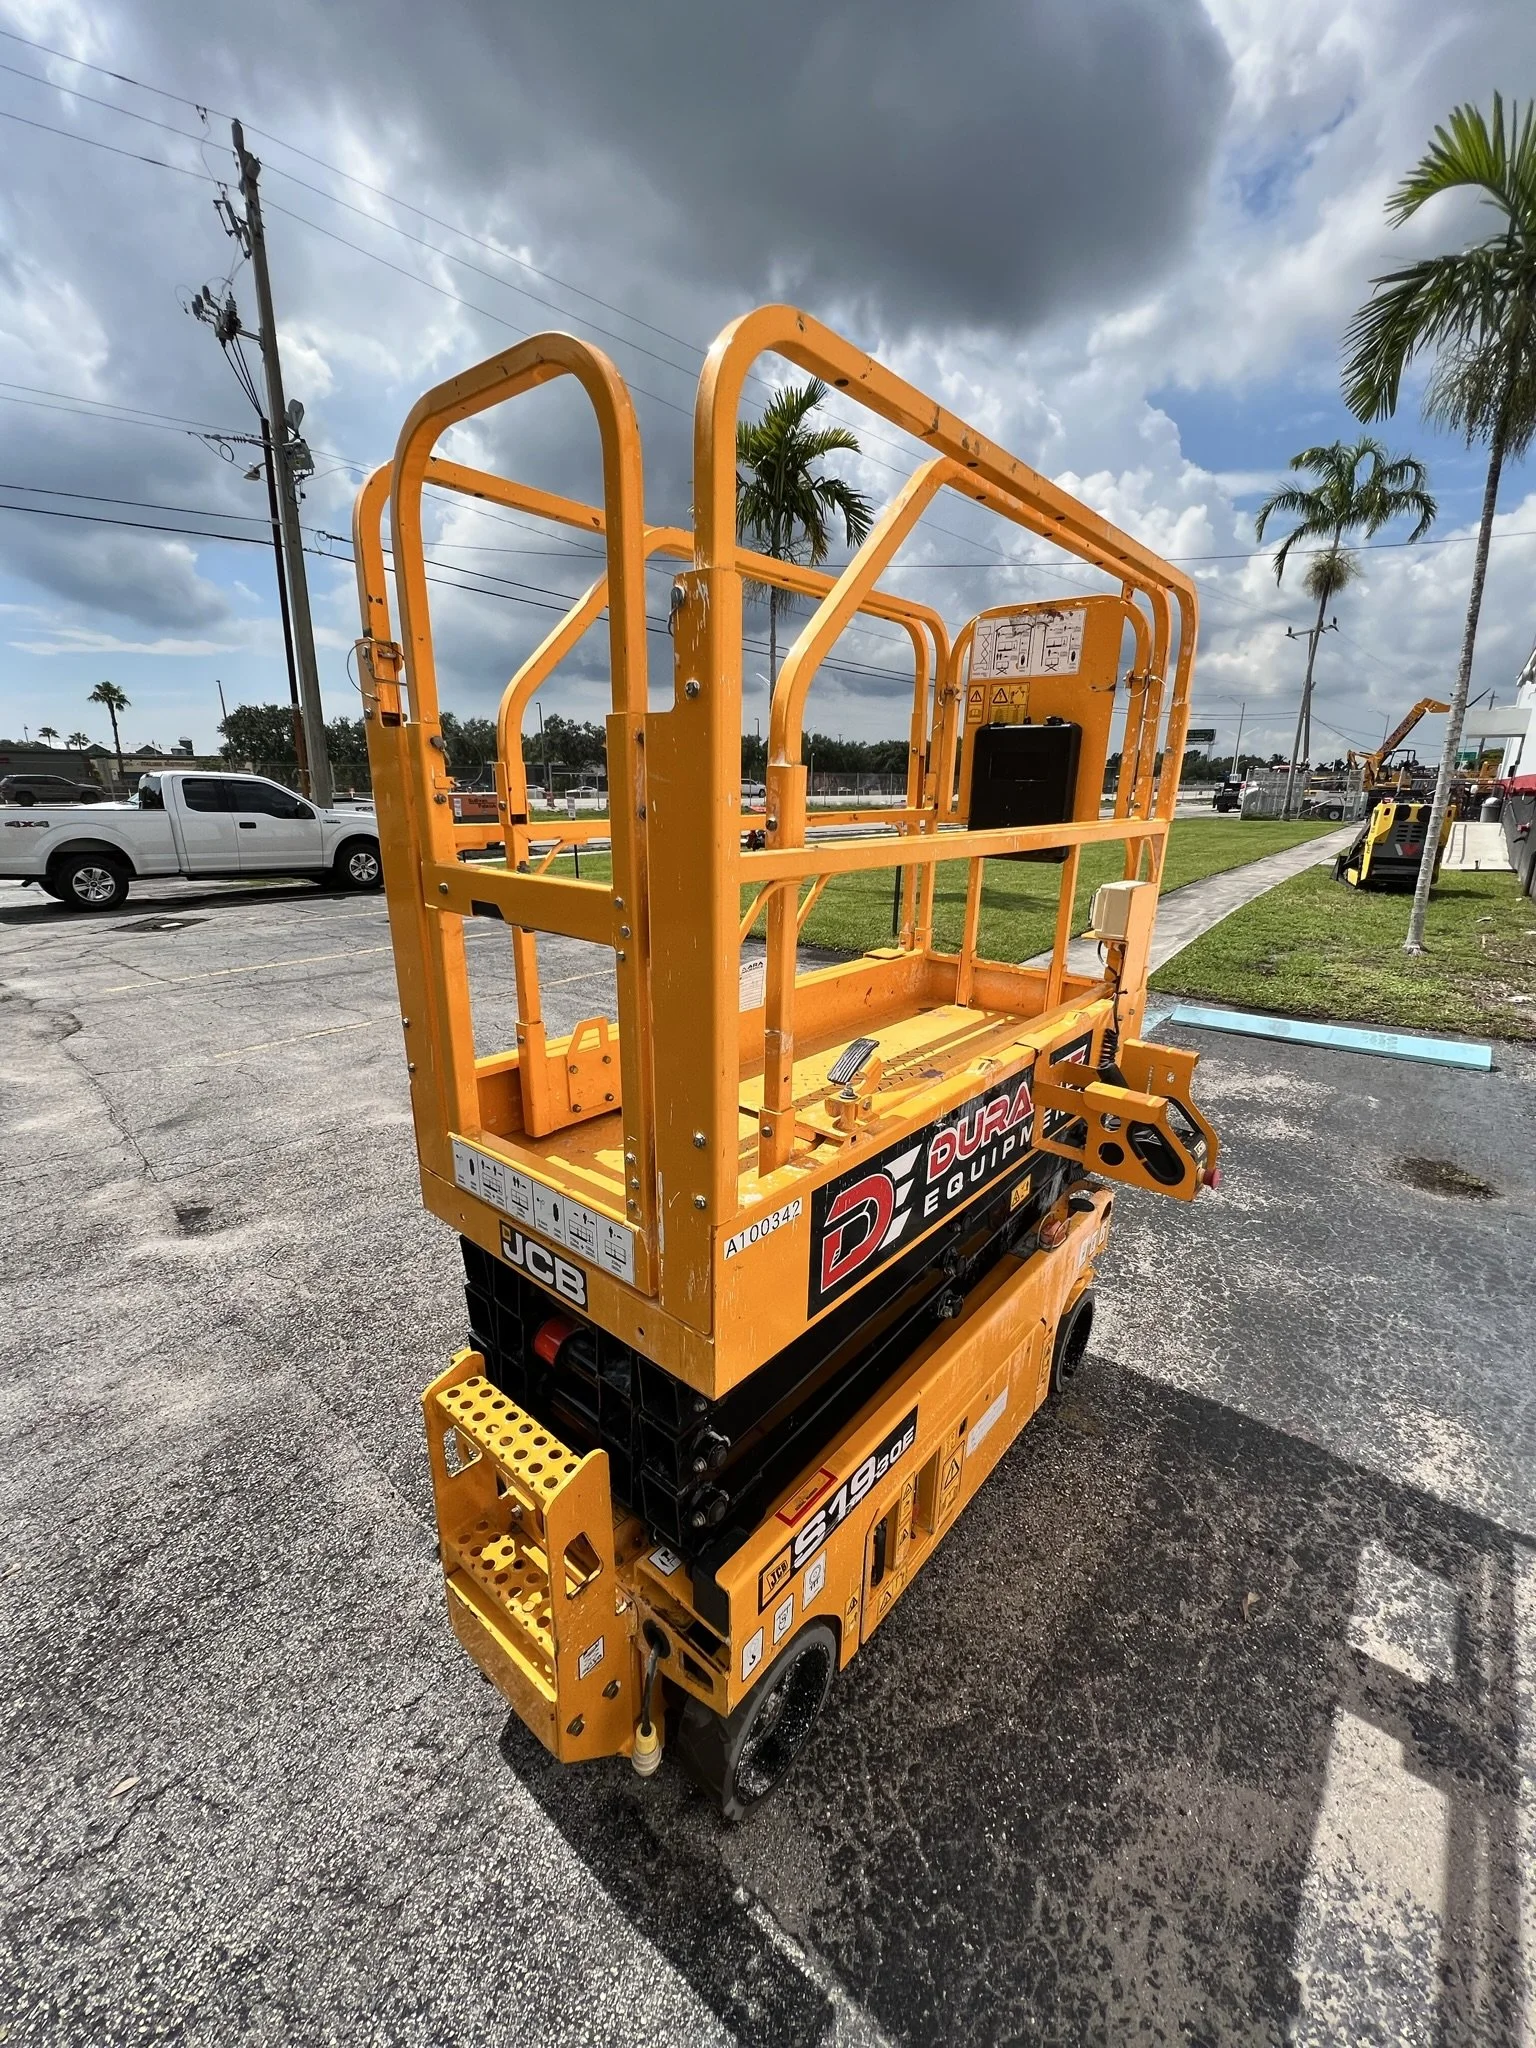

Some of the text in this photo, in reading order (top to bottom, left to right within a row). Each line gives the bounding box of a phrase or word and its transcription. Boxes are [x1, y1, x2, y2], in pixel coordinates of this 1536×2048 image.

[927, 1081, 1035, 1185] DURA
[725, 1200, 801, 1259] A100342
[502, 1232, 586, 1306] JCB
[769, 1560, 788, 1589] JCB
